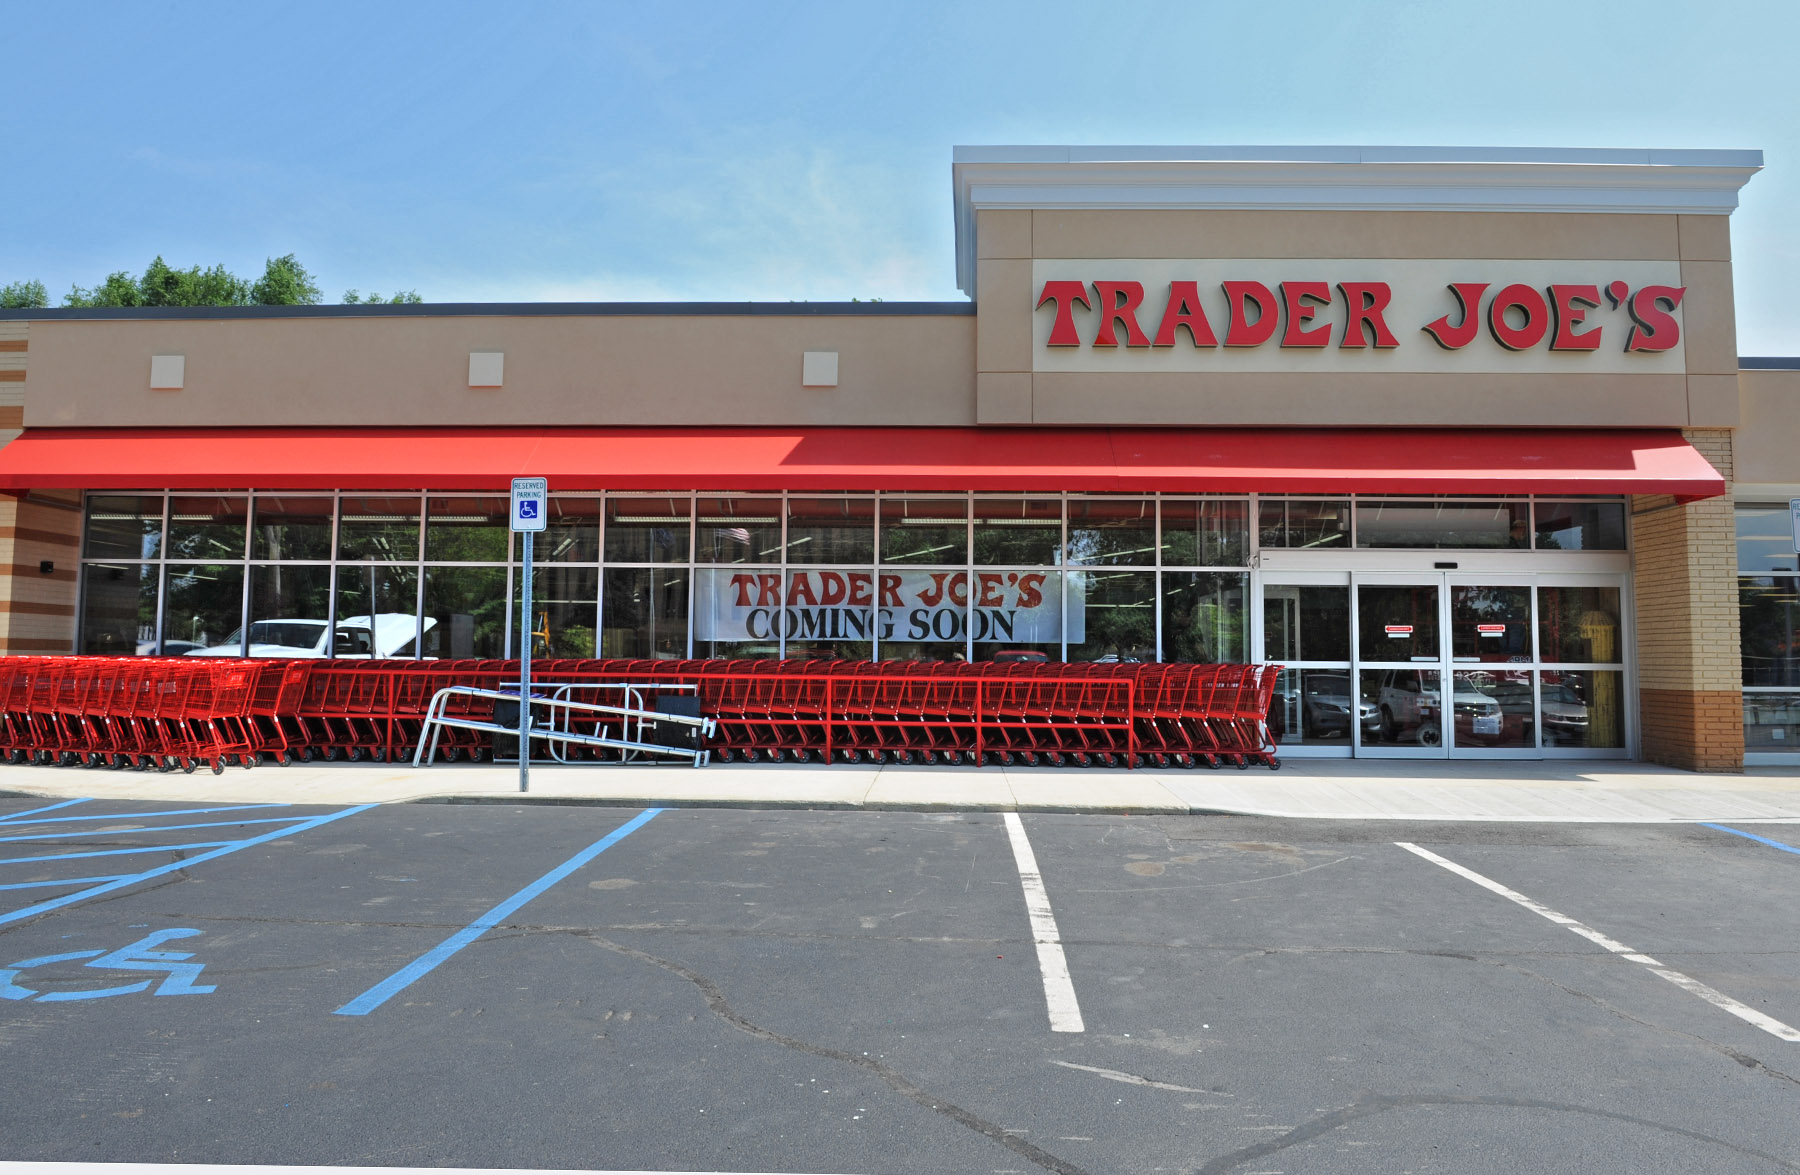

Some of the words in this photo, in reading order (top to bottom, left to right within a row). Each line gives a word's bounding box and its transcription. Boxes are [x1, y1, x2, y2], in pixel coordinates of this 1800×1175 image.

[1035, 280, 1400, 349] TRADER
[1421, 280, 1687, 352] JOE'S
[729, 572, 904, 607] TRADER
[915, 572, 1047, 608] JOE'S
[746, 609, 895, 640] COMING
[907, 608, 1018, 641] SOON
